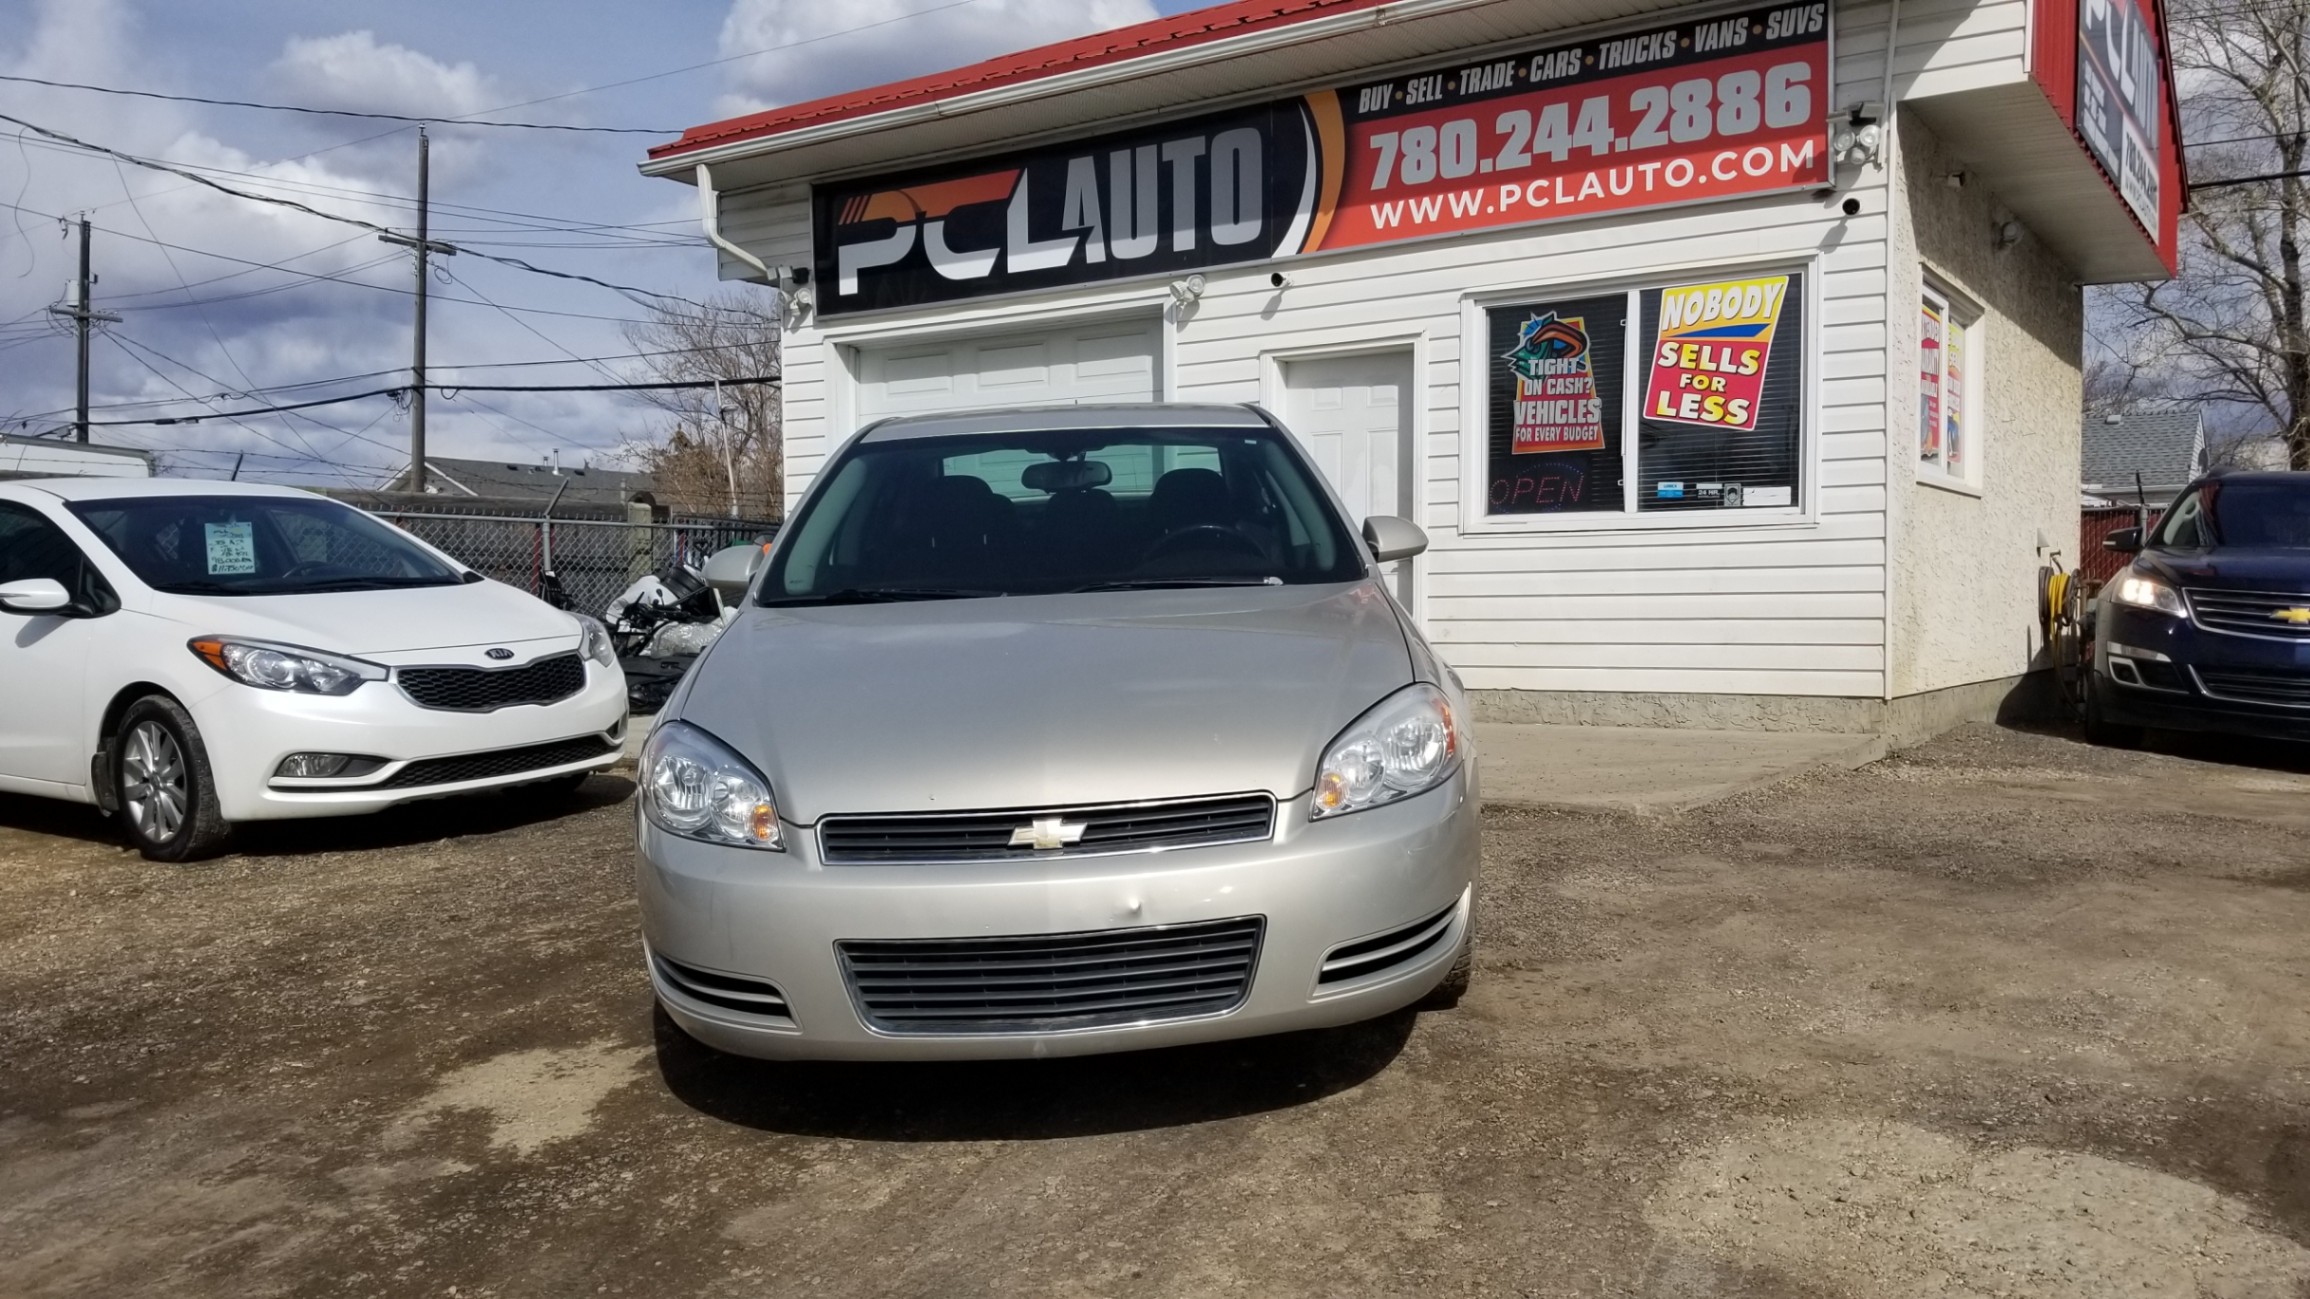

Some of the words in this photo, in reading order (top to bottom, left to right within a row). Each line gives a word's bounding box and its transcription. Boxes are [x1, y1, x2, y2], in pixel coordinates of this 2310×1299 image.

[1358, 83, 1394, 114] BUY
[1406, 74, 1443, 106] SELL
[1459, 60, 1516, 96] TRADE
[1530, 48, 1583, 83] CARS
[1599, 30, 1677, 70] TRUCKS
[1695, 17, 1749, 53] VANS
[1766, 3, 1825, 40] SUVS
[1369, 61, 1812, 191] 780.244.2886
[1370, 139, 1814, 230] WWW.PCLAUTO.COM
[1662, 282, 1783, 331] NOBODY
[1528, 357, 1579, 376] TIGHT
[1657, 341, 1761, 376] SELLS
[1524, 378, 1543, 396] ON
[1547, 377, 1593, 395] CASH?
[1679, 373, 1726, 393] FOR
[1514, 397, 1602, 425] VEHICLES
[1656, 390, 1751, 426] LESS
[1515, 427, 1532, 442] FOR
[1535, 426, 1561, 442] EVERY
[1563, 425, 1599, 441] BUDGET
[1489, 474, 1584, 504] OPEN
